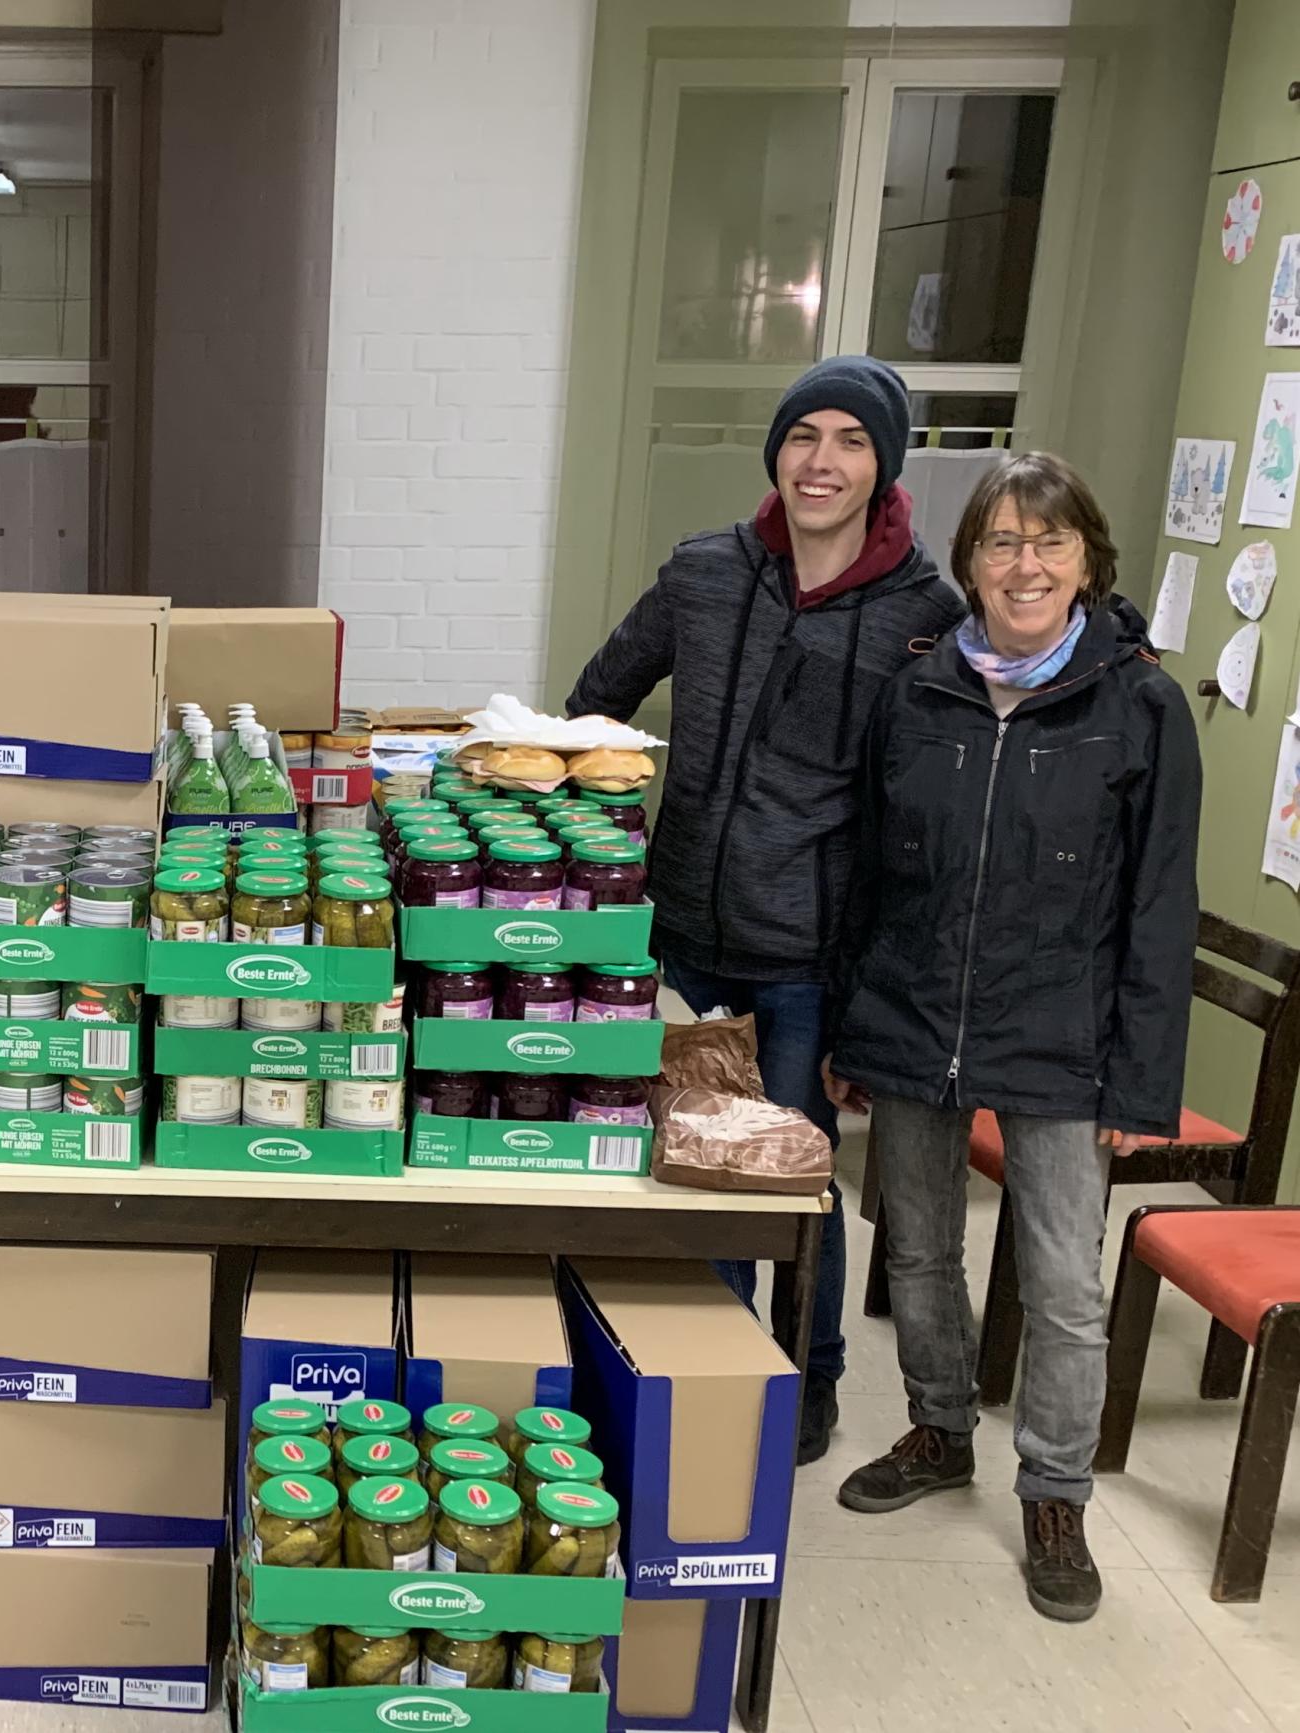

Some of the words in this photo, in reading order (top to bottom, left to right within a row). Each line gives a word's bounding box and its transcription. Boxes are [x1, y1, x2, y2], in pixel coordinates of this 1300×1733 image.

[504, 933, 530, 944] Beste
[532, 934, 559, 945] Ernte
[1, 948, 22, 958] Beste
[23, 949, 44, 958] Ernte
[237, 967, 265, 979] Beste
[268, 969, 295, 981] Ernte
[516, 1043, 542, 1055] Beste
[544, 1044, 571, 1056] Ernte
[251, 1063, 308, 1075] BRECHBOHNEN
[256, 1146, 277, 1156] Beste
[278, 1148, 299, 1157] Ernte
[469, 1155, 518, 1167] DELIKATESS
[520, 1156, 585, 1170] APFELROTKOHL
[297, 1363, 361, 1385] Priva
[36, 1377, 64, 1391] FEIN
[18, 1525, 53, 1539] Priva
[56, 1522, 84, 1536] FEIN
[638, 1563, 676, 1579] Priva
[681, 1561, 768, 1579] SPÜLMITTEL
[401, 1595, 433, 1608] Beste
[435, 1597, 467, 1609] Ernte
[43, 1680, 78, 1693] Priva
[81, 1680, 109, 1694] FEIN
[389, 1708, 419, 1721] Beste
[422, 1710, 453, 1722] Ernte
